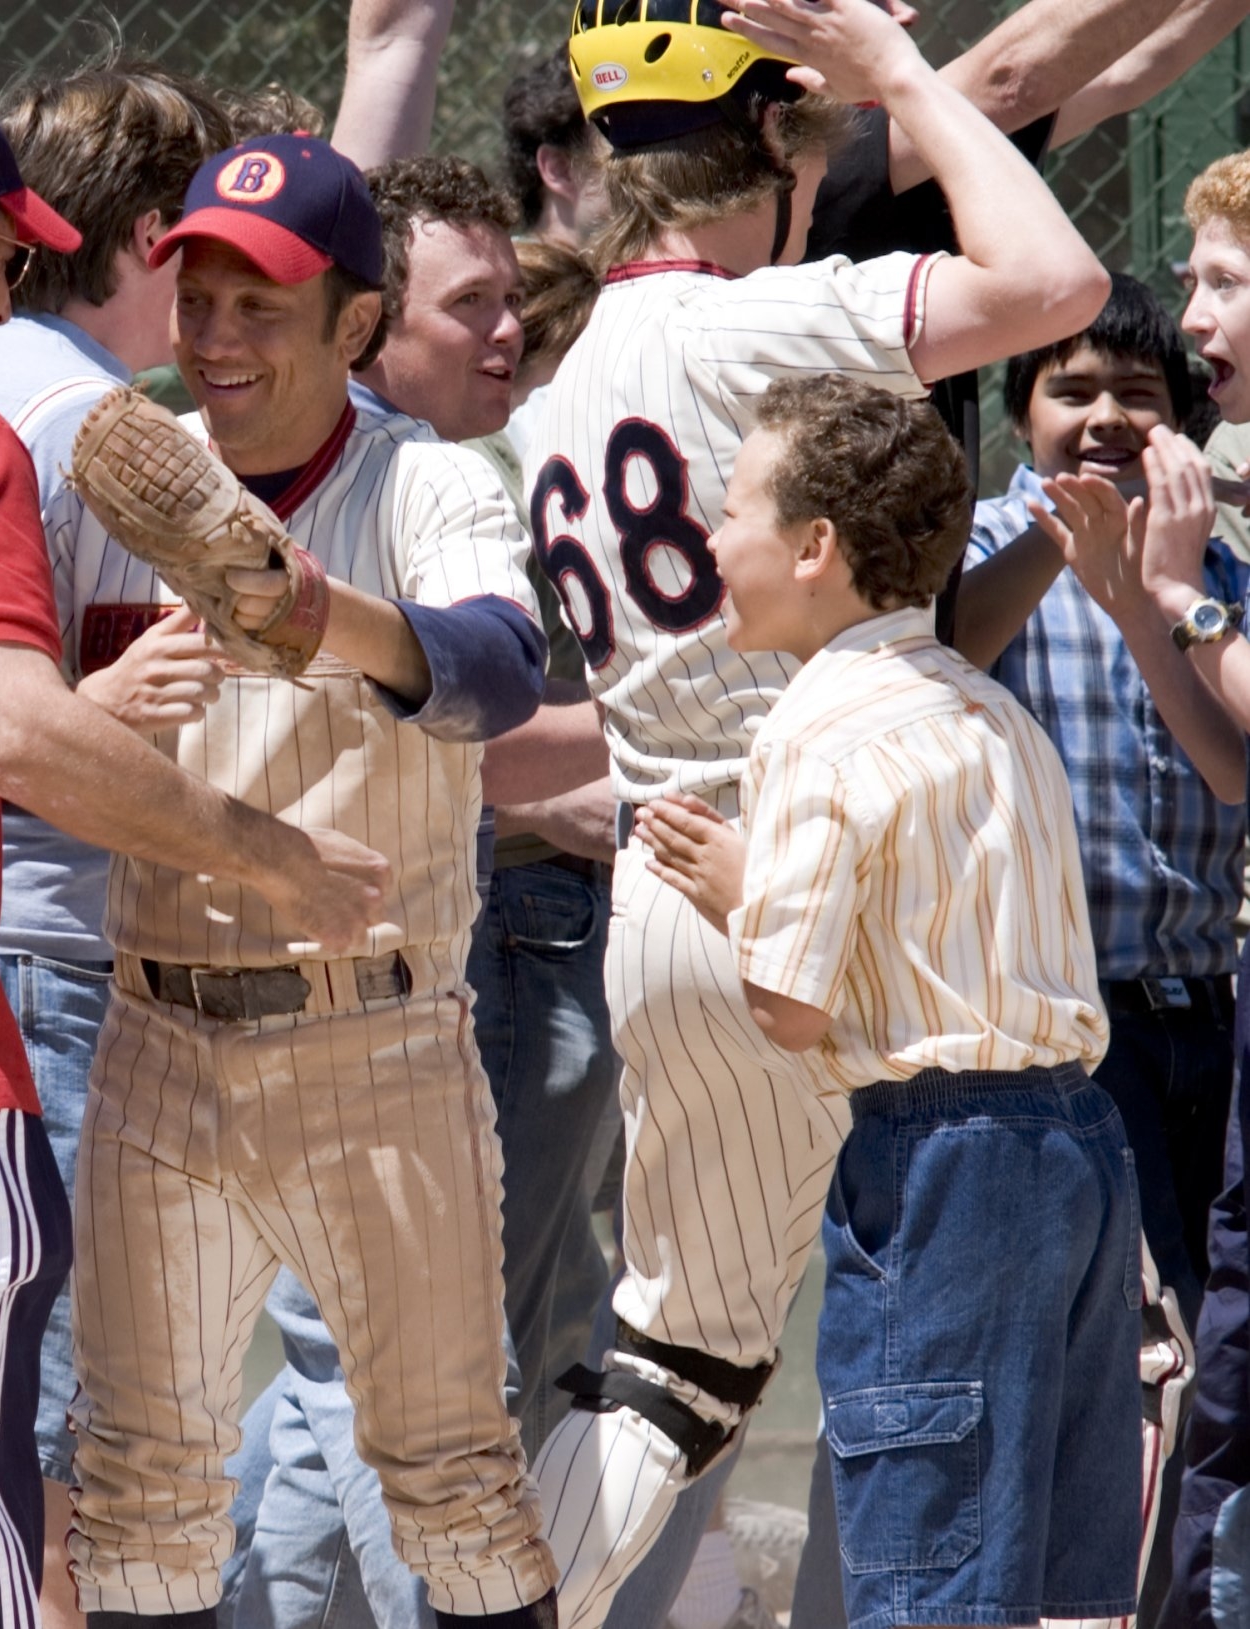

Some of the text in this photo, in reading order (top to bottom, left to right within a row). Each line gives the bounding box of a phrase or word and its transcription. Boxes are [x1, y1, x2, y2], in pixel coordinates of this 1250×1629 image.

[595, 69, 622, 84] BELL
[228, 157, 271, 193] B
[530, 416, 727, 671] 68
